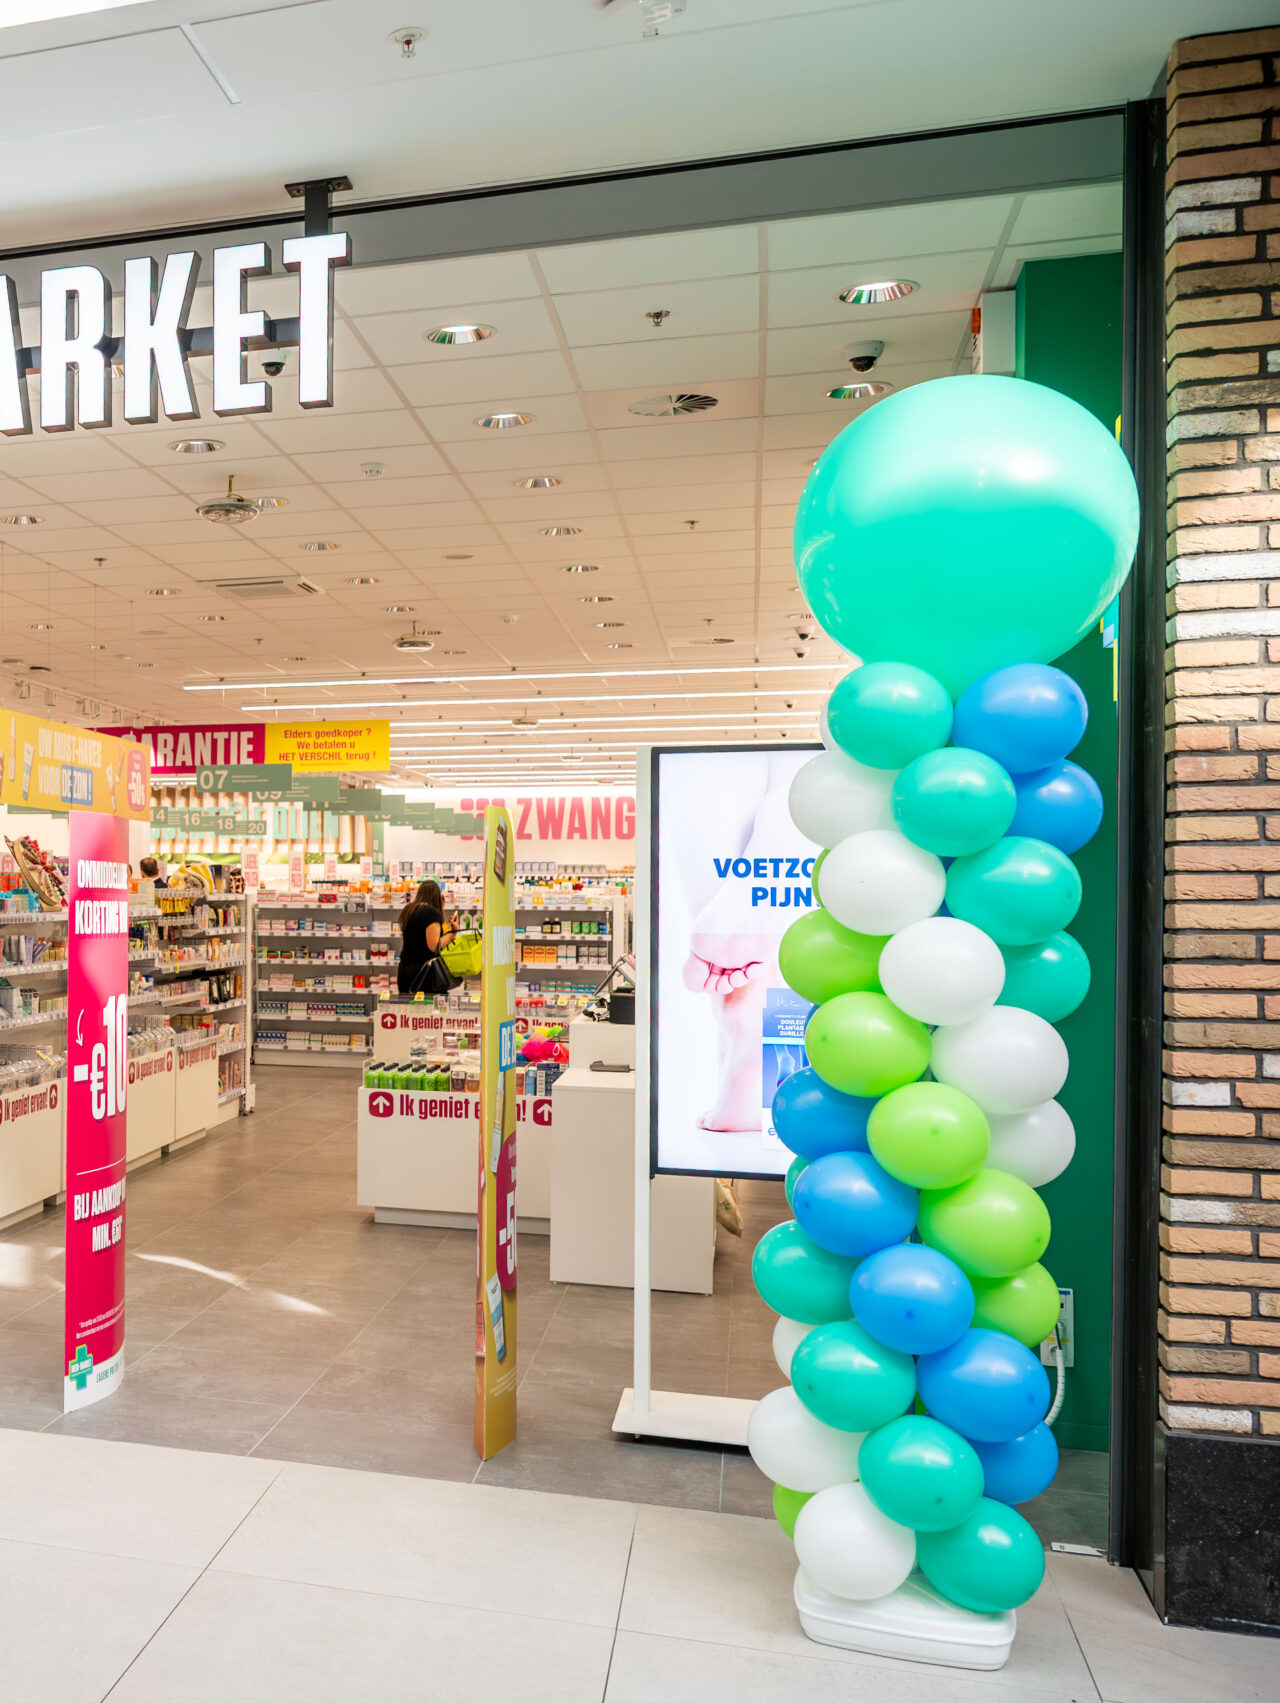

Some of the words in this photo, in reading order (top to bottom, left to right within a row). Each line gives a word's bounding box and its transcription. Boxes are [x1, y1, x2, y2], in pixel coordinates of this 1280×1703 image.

[284, 729, 312, 739] Elders
[314, 729, 363, 740] goedkoper
[296, 740, 311, 749] We
[313, 740, 347, 749] betalen
[348, 741, 356, 749] u
[279, 752, 296, 762] HET
[298, 751, 342, 761] VERSCHIL
[345, 751, 370, 762] terug
[200, 770, 229, 790] 07
[182, 813, 201, 825] 16
[216, 818, 234, 830] 18
[516, 797, 636, 840] ZWANG
[248, 822, 265, 834] 20
[751, 887, 812, 908] PIJN
[400, 1014, 410, 1029] Ik
[411, 1014, 444, 1031] geniet
[4, 1097, 11, 1122] Ik
[11, 1093, 29, 1123] geniet
[399, 1094, 415, 1117] Ik
[418, 1096, 470, 1120] geniet
[74, 1192, 90, 1221] BIJ
[92, 1222, 111, 1253] MIN.
